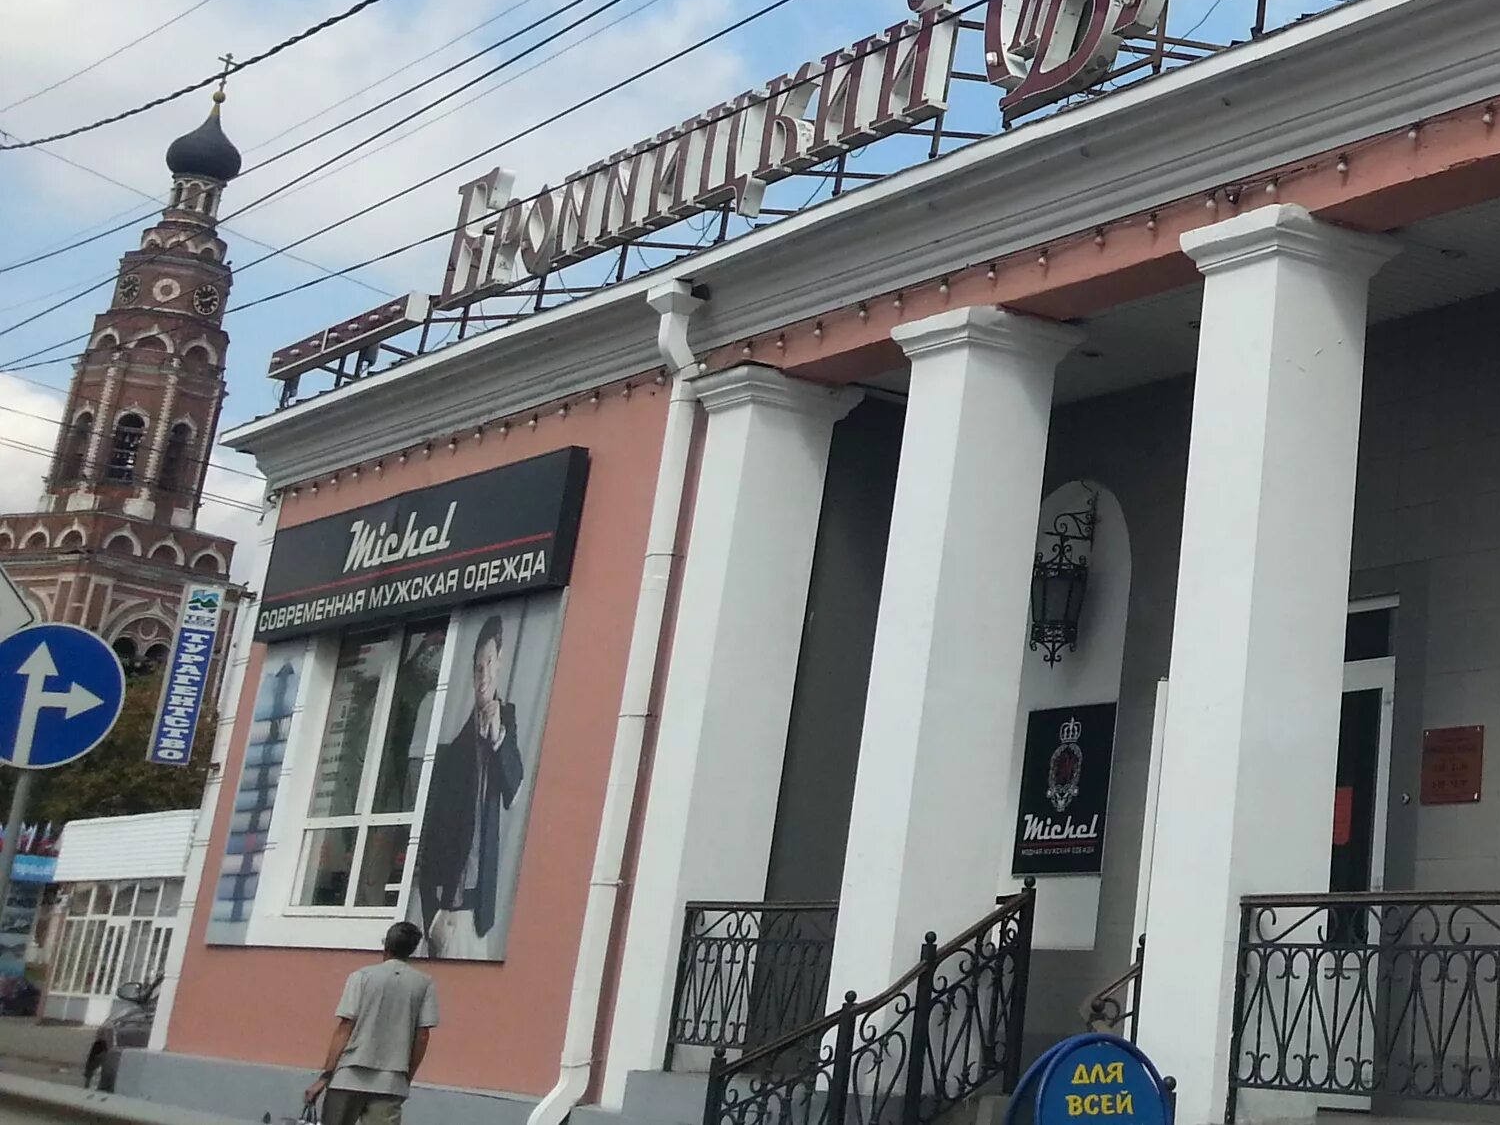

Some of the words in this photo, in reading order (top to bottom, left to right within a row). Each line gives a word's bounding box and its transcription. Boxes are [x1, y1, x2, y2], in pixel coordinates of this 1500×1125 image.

[343, 501, 458, 574] Michel
[258, 589, 366, 633] СОВРЕМЕННАЯ
[368, 568, 459, 610] МУЖСКАЯ
[463, 550, 547, 591] ОДЕЖДА
[157, 631, 210, 761] ТУРАГЕНТСТВО
[1023, 813, 1099, 842] Michel
[1071, 1062, 1125, 1084] ДЛЯ
[1065, 1090, 1135, 1116] ВСЕЙ
